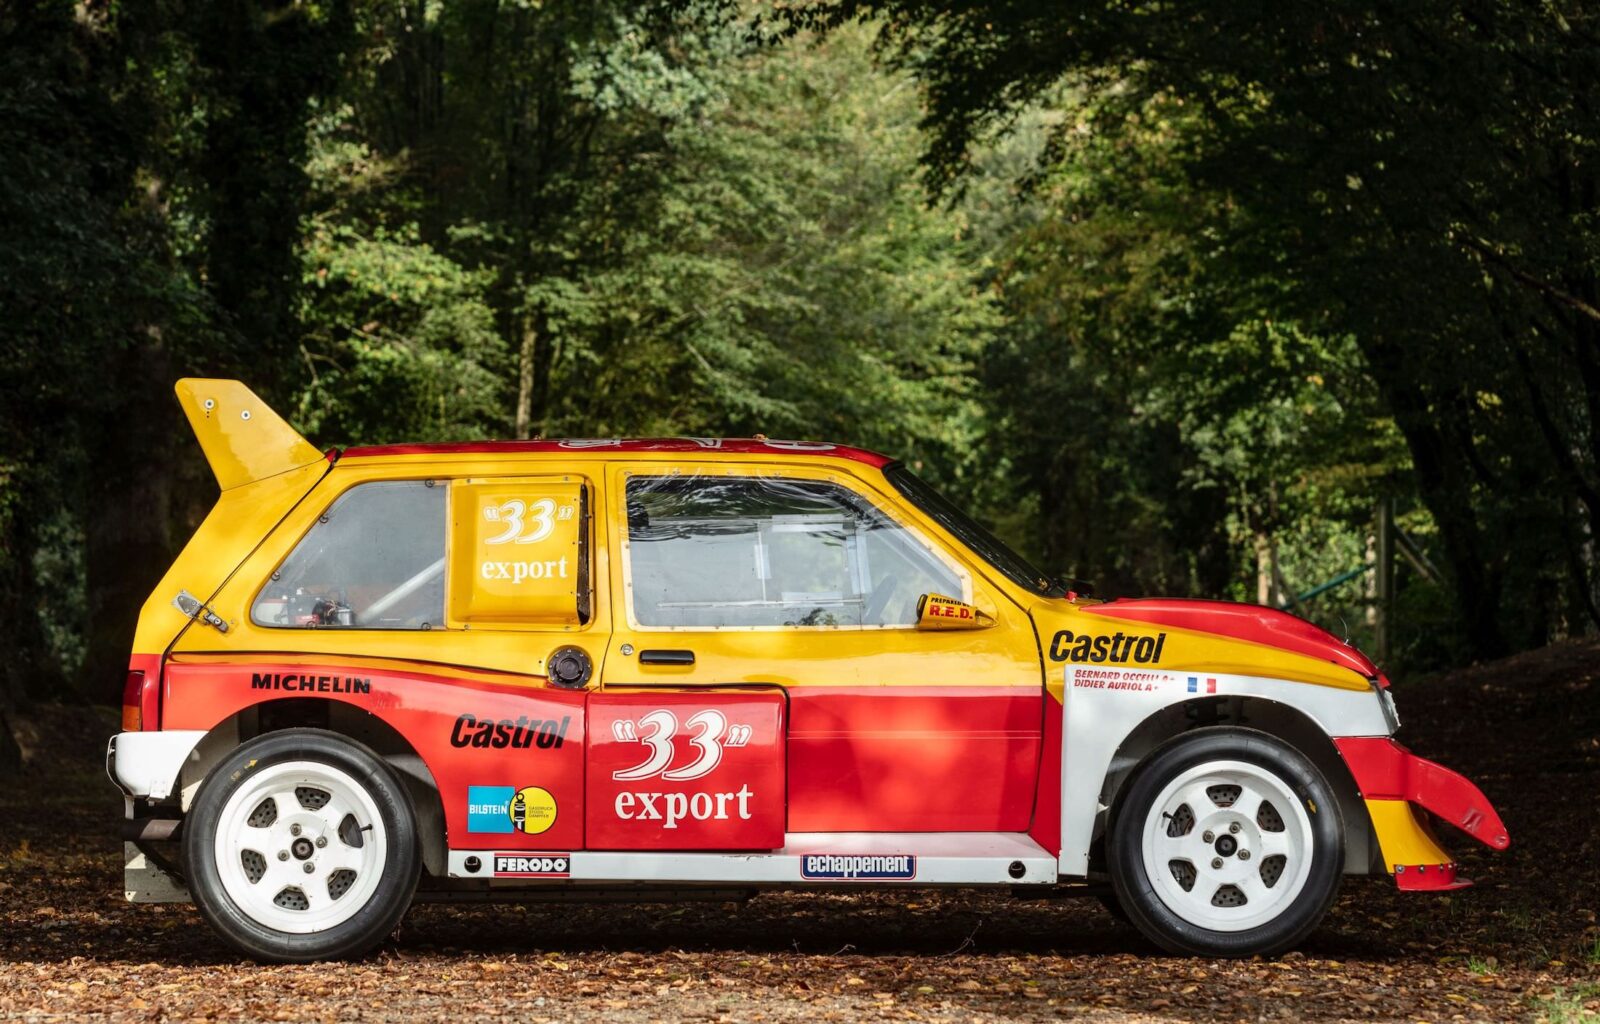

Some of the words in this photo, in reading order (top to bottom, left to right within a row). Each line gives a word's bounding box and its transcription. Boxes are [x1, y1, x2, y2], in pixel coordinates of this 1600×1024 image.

[481, 556, 568, 584] export
[929, 604, 973, 619] R.E.D.
[1049, 630, 1166, 663] Castrol
[252, 673, 370, 694] MICHELIN
[1074, 679, 1105, 688] DIDIER
[1107, 680, 1142, 691] AURIOL
[1075, 669, 1120, 680] BERNARD
[450, 713, 571, 749] Castrol
[469, 804, 508, 814] BILSTEIN
[615, 783, 754, 829] export
[497, 858, 567, 872] FERODO
[807, 855, 909, 877] echappement
